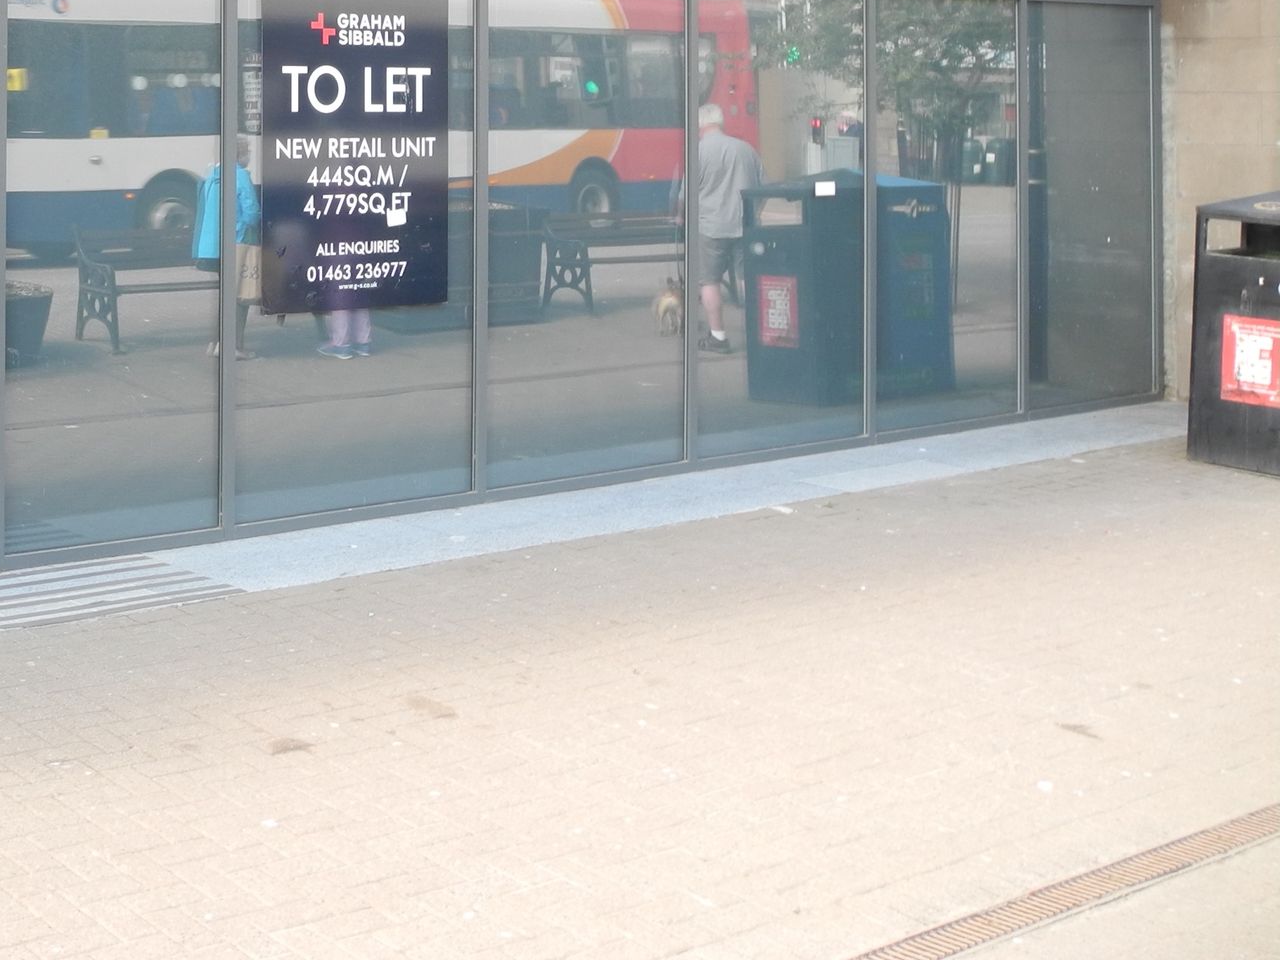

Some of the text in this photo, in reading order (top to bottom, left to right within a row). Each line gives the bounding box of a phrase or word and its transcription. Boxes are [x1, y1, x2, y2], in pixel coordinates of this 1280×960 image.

[337, 13, 405, 30] GRAHAM
[338, 30, 406, 47] SIBBALD
[281, 65, 346, 114] TO
[364, 66, 431, 113] LET
[275, 137, 436, 159] NEW RETAIL UNIT
[306, 165, 394, 187] 444SQ.M
[315, 240, 400, 256] ALL ENQUIRIES
[307, 261, 407, 282] 01463 236977
